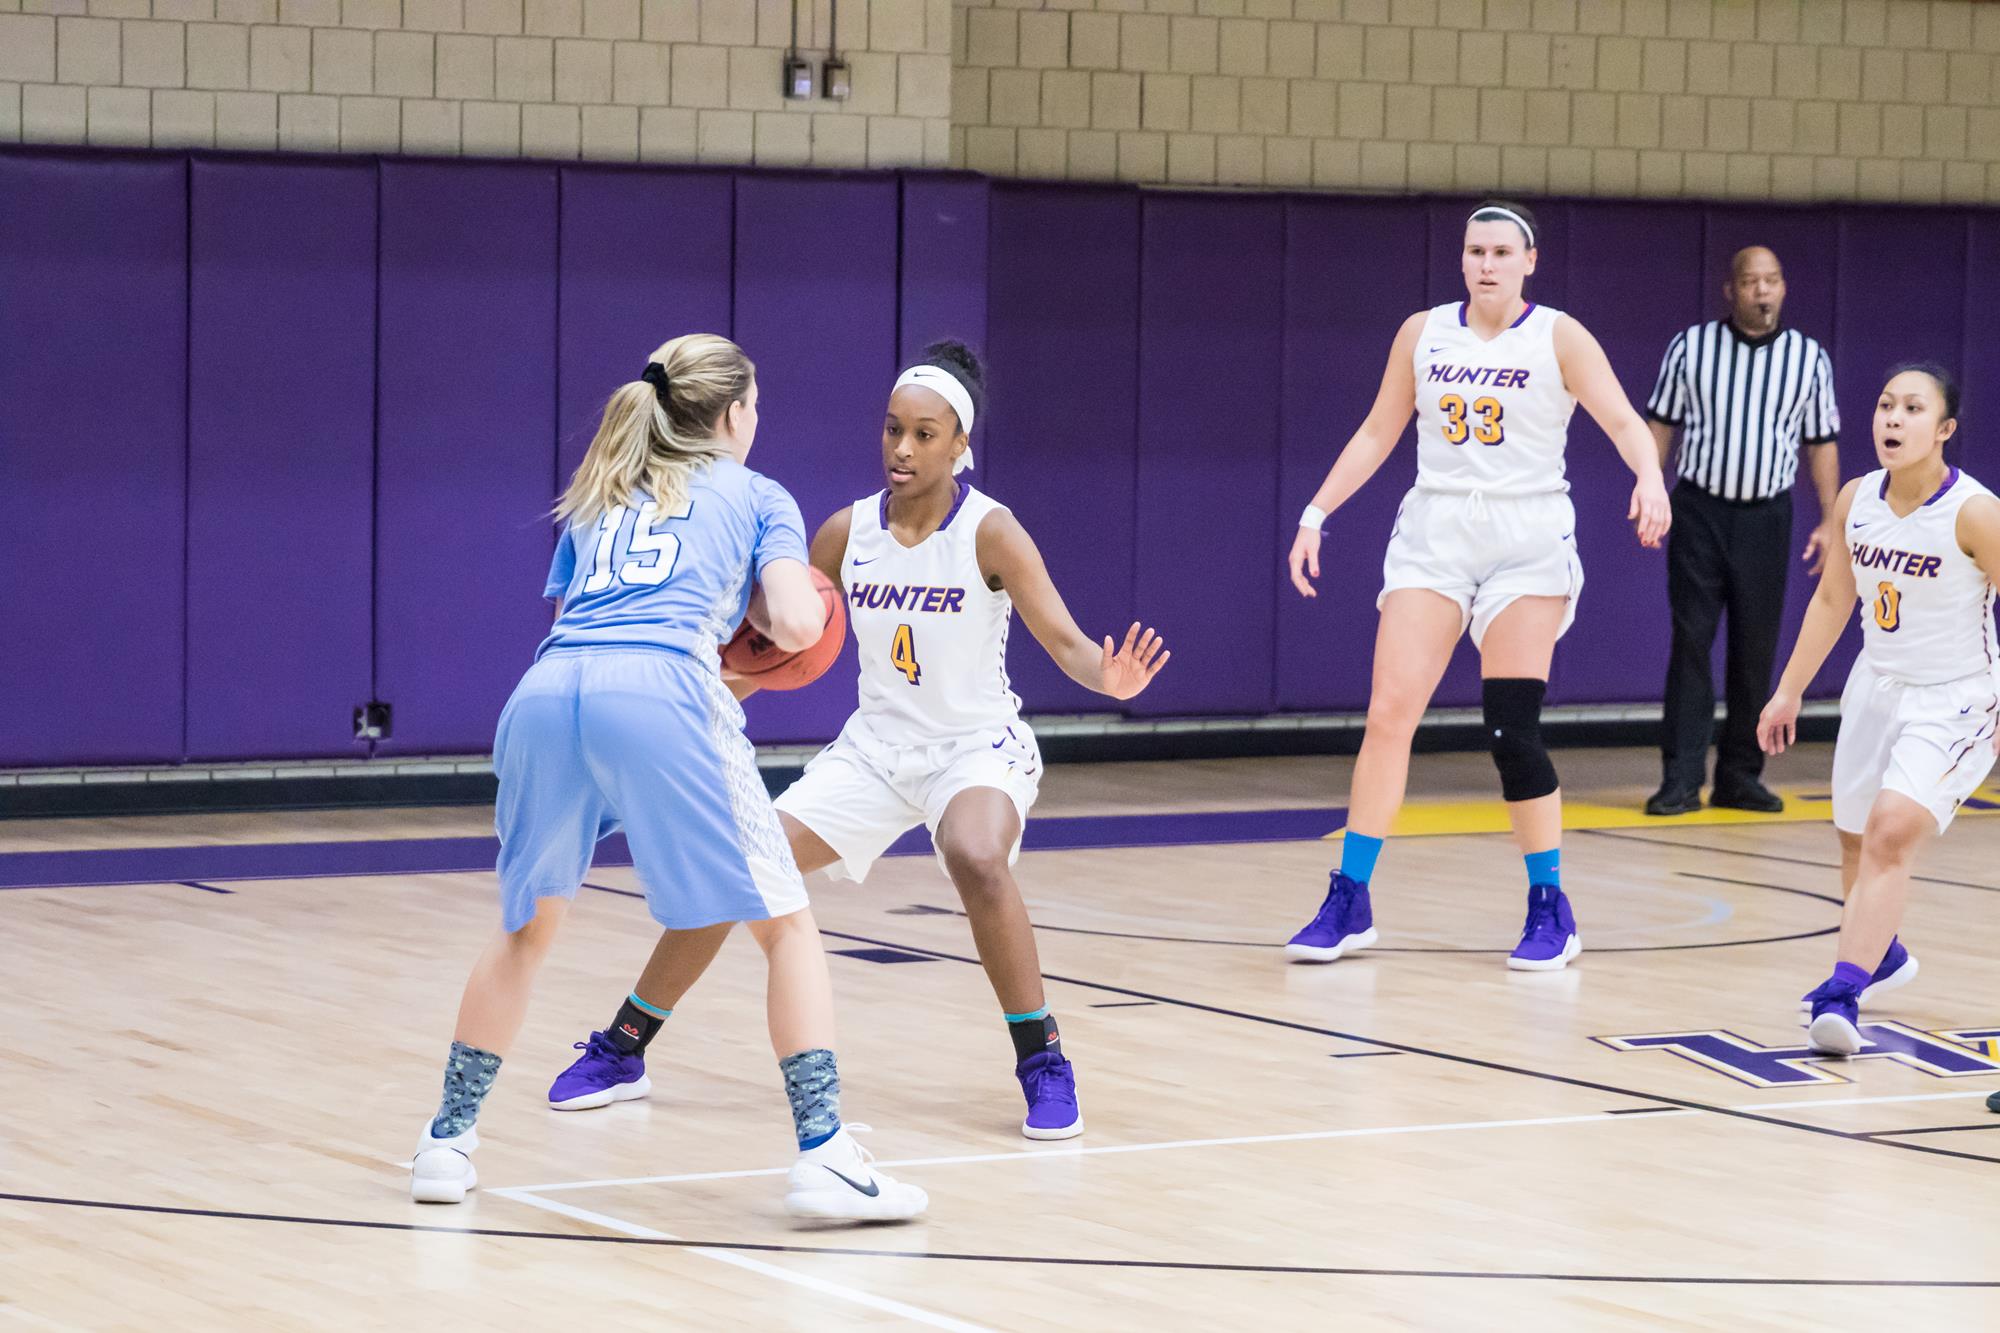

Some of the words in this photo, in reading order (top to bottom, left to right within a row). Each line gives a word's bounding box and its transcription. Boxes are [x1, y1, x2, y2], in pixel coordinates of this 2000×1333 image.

[1428, 364, 1530, 388] HUNTER
[1439, 393, 1505, 446] 33
[581, 500, 694, 595] 15
[1852, 542, 1942, 578] HUNTER
[850, 582, 966, 612] HUNTER
[1874, 581, 1902, 633] 0
[890, 623, 921, 686] 4
